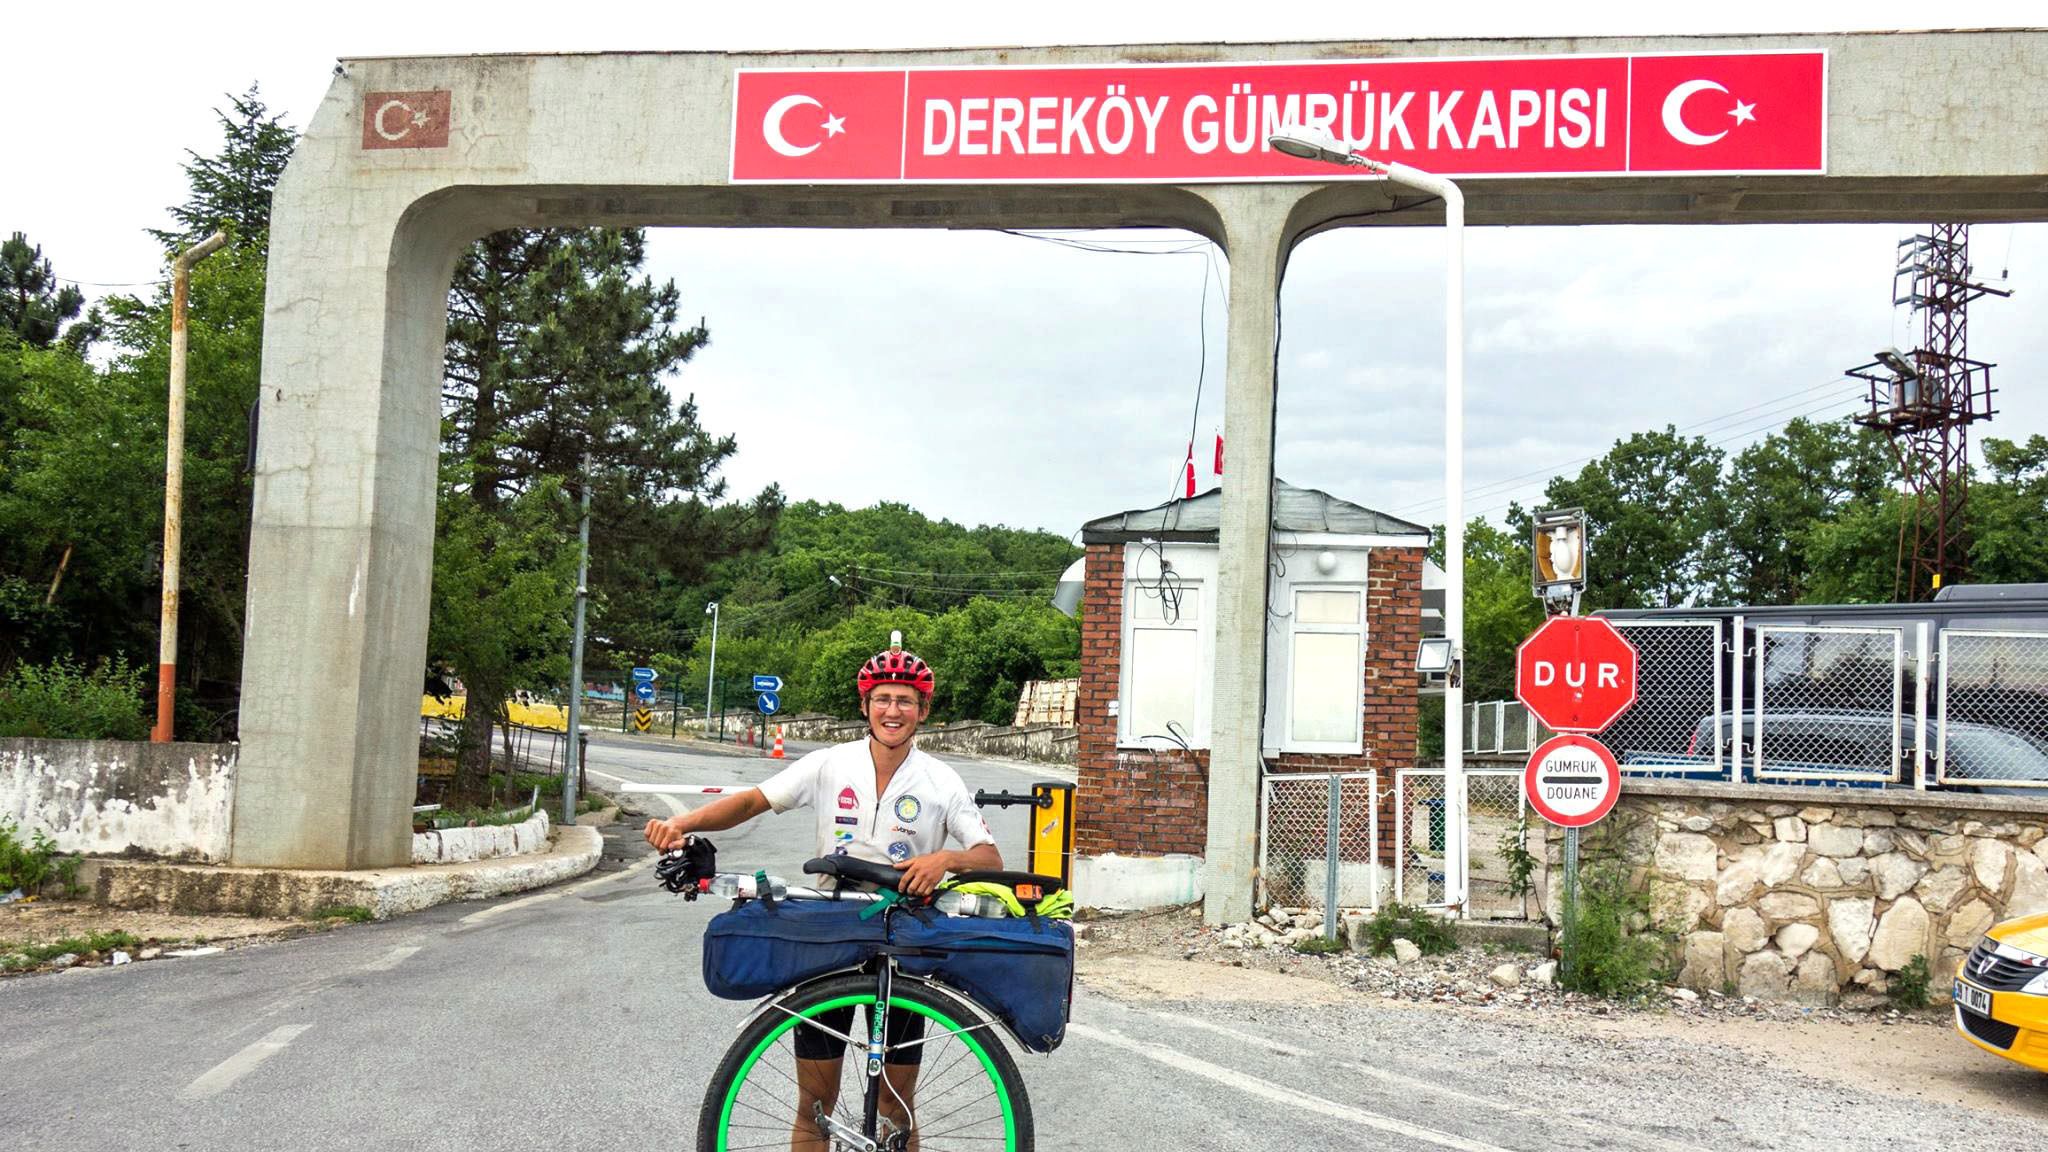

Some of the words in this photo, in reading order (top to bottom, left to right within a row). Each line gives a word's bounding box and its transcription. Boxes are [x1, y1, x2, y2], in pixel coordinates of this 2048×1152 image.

[923, 84, 1170, 155] DEREKÖY
[1182, 80, 1416, 154] GÜMRÜK
[1429, 88, 1607, 150] KAPISI
[1534, 661, 1620, 688] DUR
[1547, 787, 1598, 800] DOUANE
